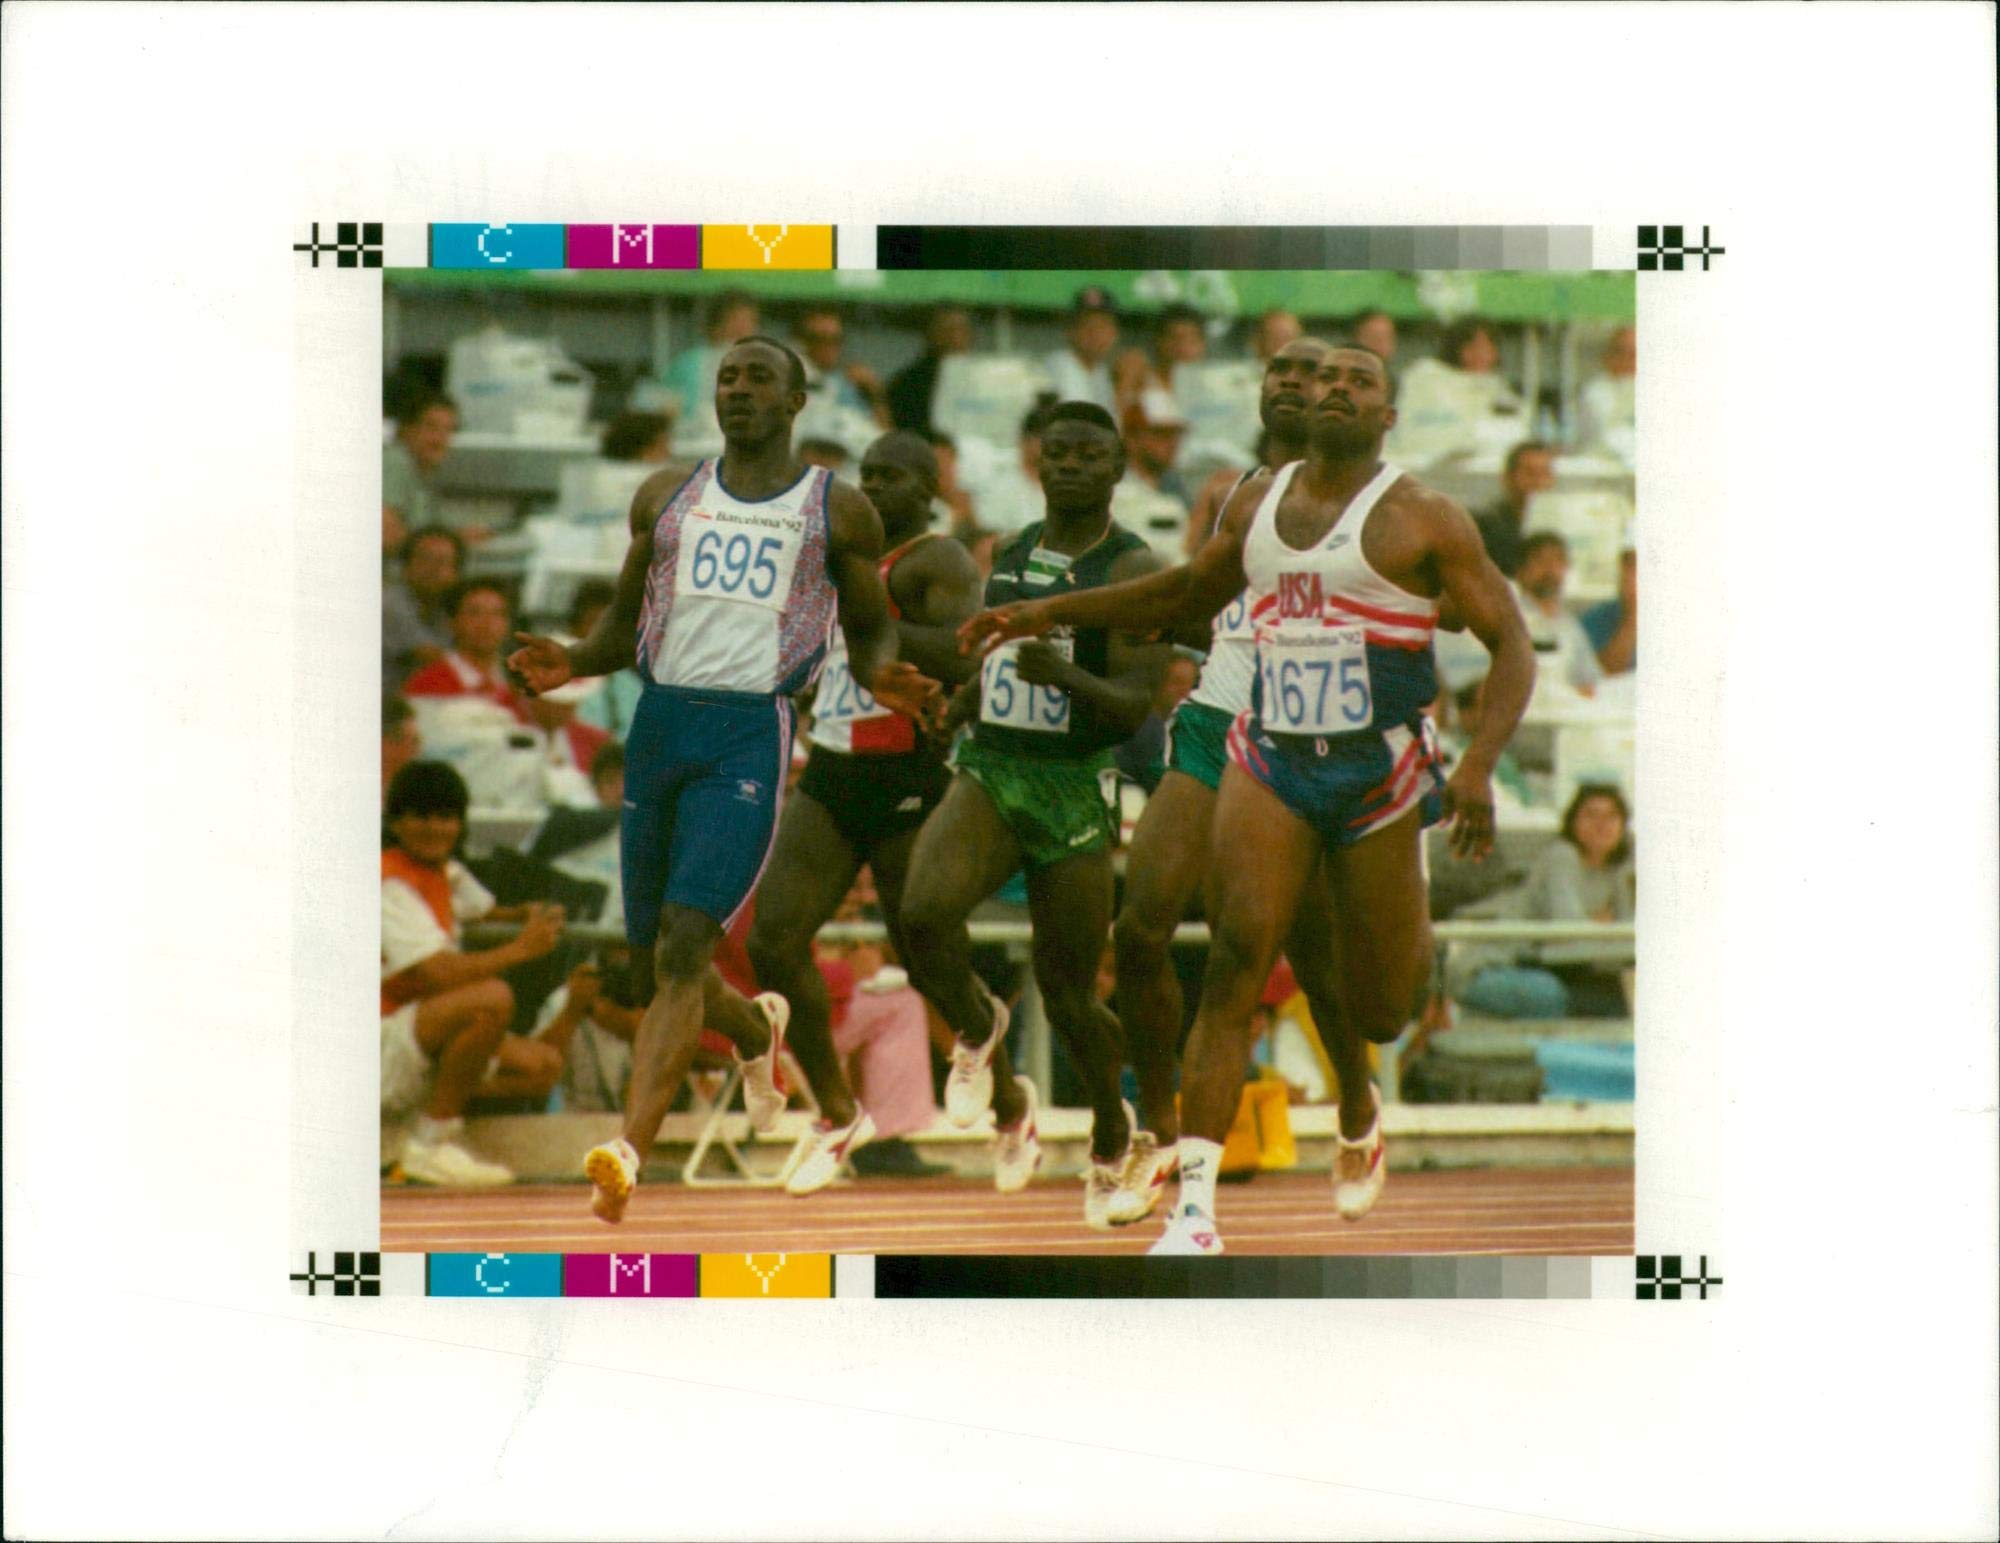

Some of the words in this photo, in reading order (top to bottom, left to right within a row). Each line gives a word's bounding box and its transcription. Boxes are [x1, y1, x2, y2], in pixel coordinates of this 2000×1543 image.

[478, 223, 512, 263] C
[613, 223, 653, 264] M
[747, 223, 787, 264] Y
[715, 510, 780, 529] Barcelona
[692, 530, 784, 599] 695
[1278, 572, 1325, 619] USA
[1265, 656, 1369, 727] 1675
[475, 1253, 510, 1293] C
[610, 1253, 650, 1293] M
[745, 1253, 785, 1293] Y
